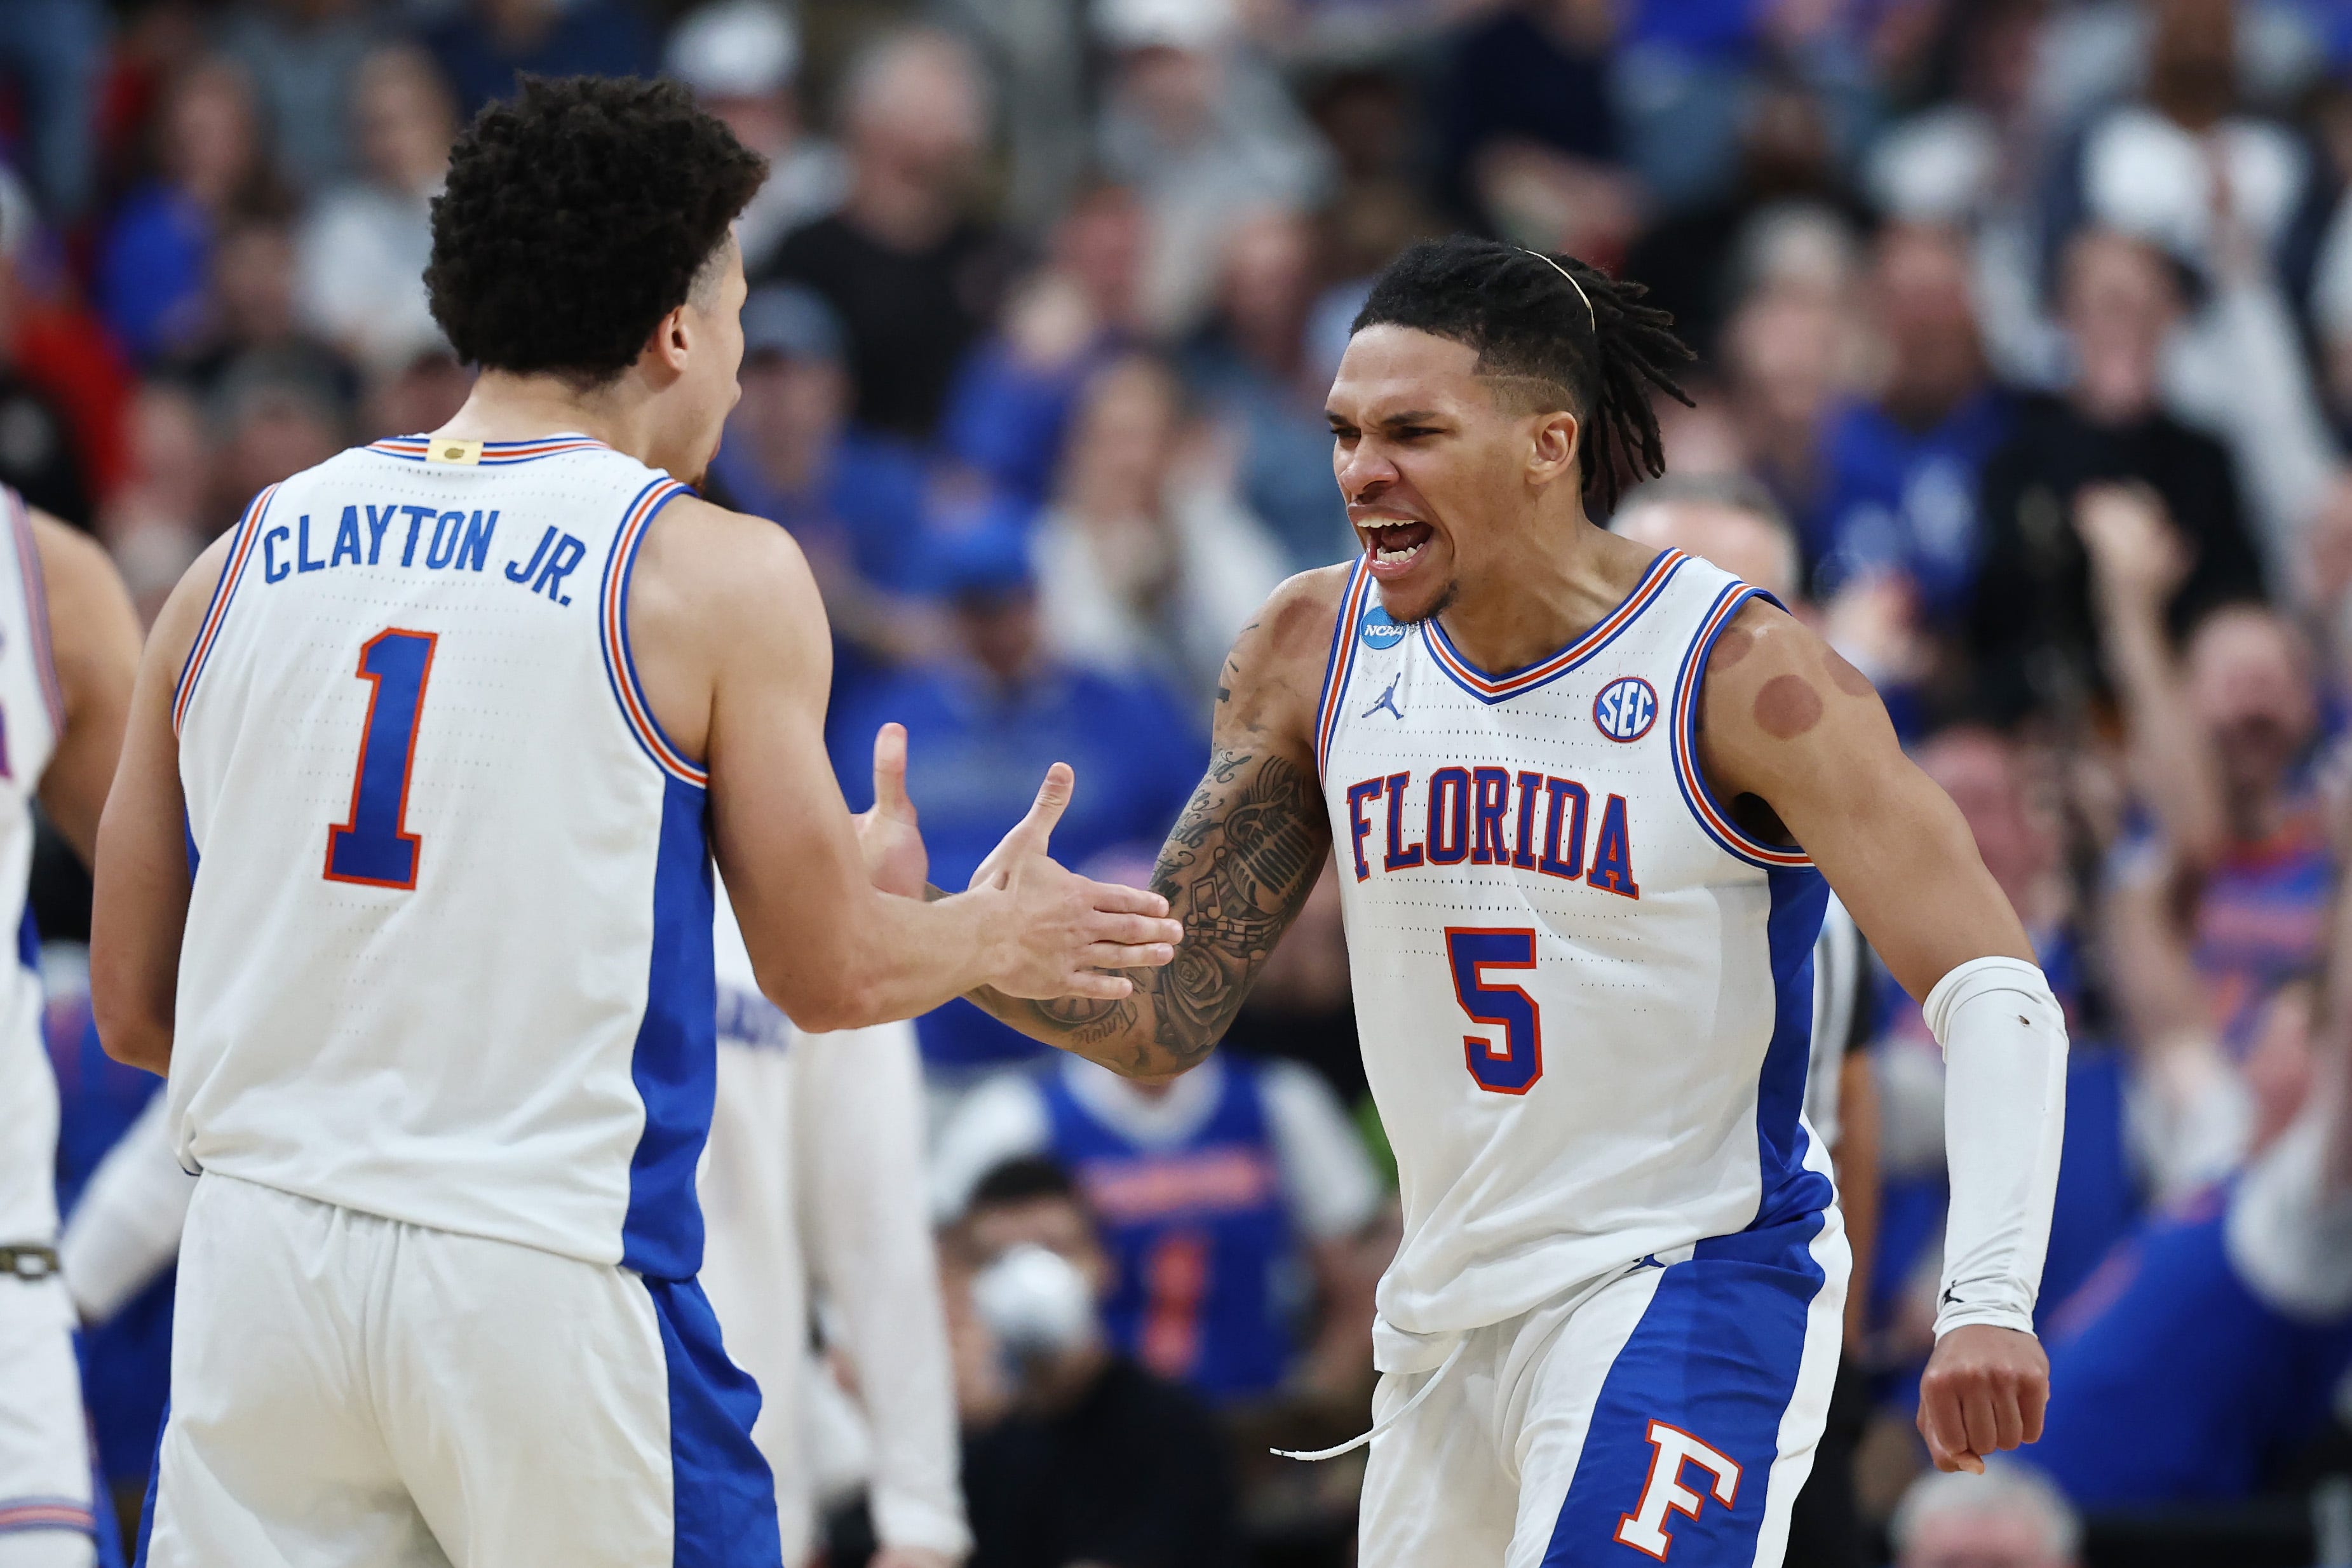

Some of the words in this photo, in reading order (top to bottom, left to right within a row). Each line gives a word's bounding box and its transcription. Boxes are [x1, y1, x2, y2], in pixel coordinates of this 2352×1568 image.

[264, 505, 500, 585] CLAYTON
[504, 525, 586, 607] JR.
[323, 626, 438, 891] 1
[1600, 682, 1652, 737] SEC
[1346, 766, 1639, 900] FLORIDA
[1444, 926, 1543, 1095] 5
[1612, 1418, 1744, 1563] F
